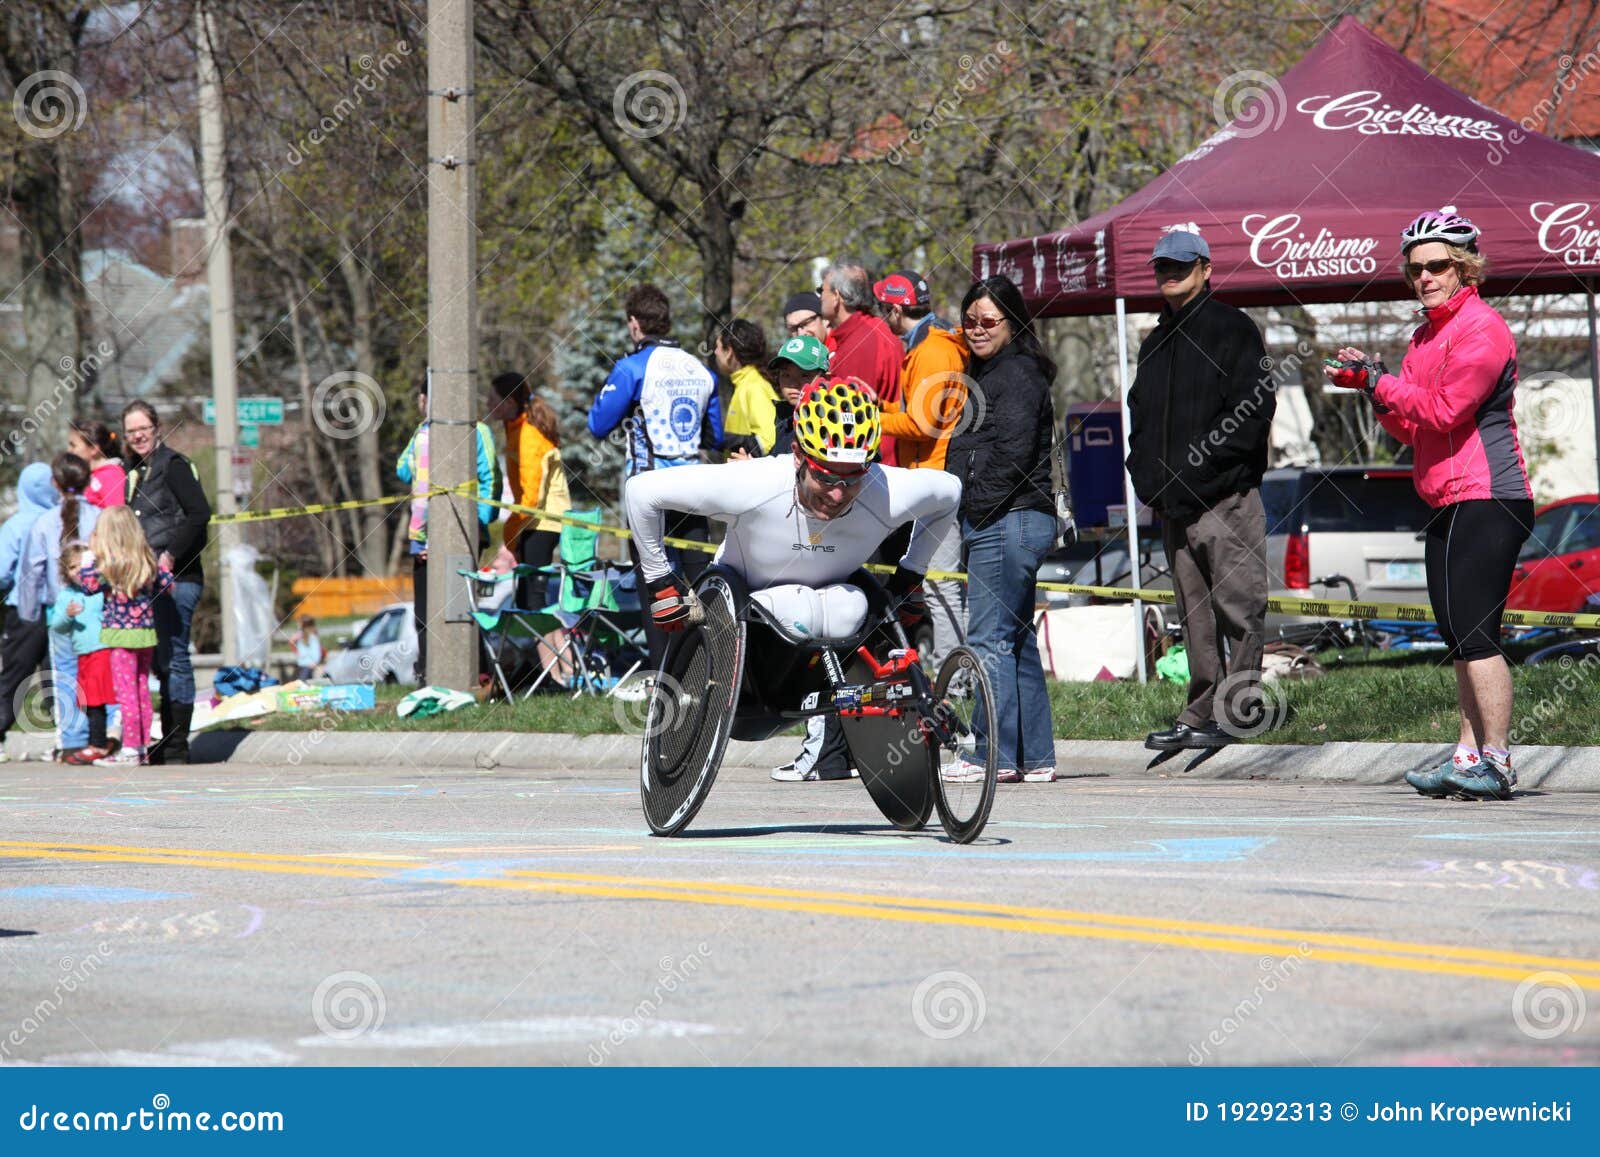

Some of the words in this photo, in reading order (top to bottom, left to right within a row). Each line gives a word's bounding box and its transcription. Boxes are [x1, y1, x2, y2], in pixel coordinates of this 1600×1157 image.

[1296, 90, 1499, 130] Ciclismo
[1358, 122, 1503, 142] CLASSICO
[1241, 213, 1379, 267] Ciclismo
[1276, 256, 1377, 279] CLASSICO
[1301, 602, 1330, 616] CAUTION
[1350, 605, 1379, 619] CAUTION
[1397, 607, 1427, 621] CAUTION
[1543, 614, 1576, 626] CAUTION
